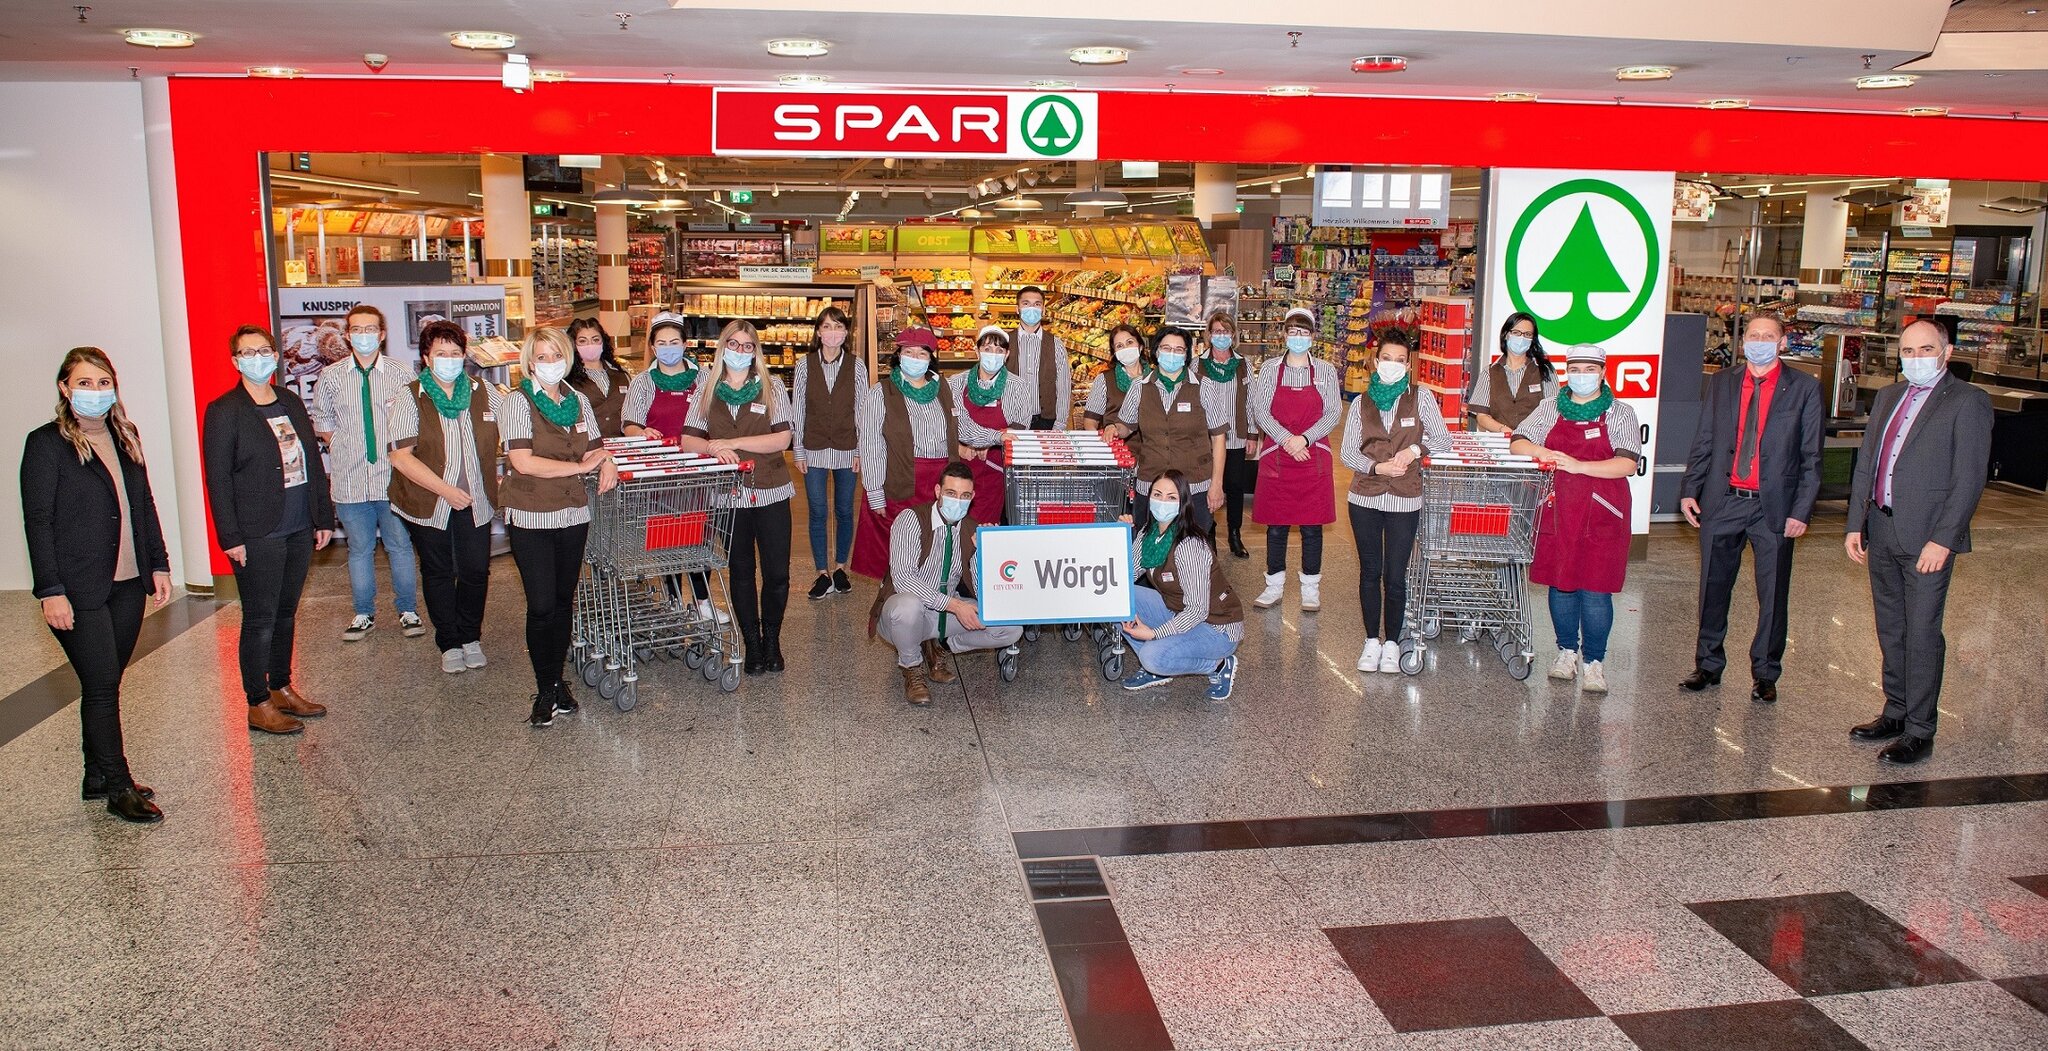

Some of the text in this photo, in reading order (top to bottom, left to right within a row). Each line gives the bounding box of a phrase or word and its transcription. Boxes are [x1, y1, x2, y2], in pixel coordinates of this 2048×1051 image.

[773, 104, 999, 142] SPAR
[917, 236, 951, 246] OBST
[452, 302, 500, 312] INFORMATION
[1034, 557, 1118, 596] Wörgl
